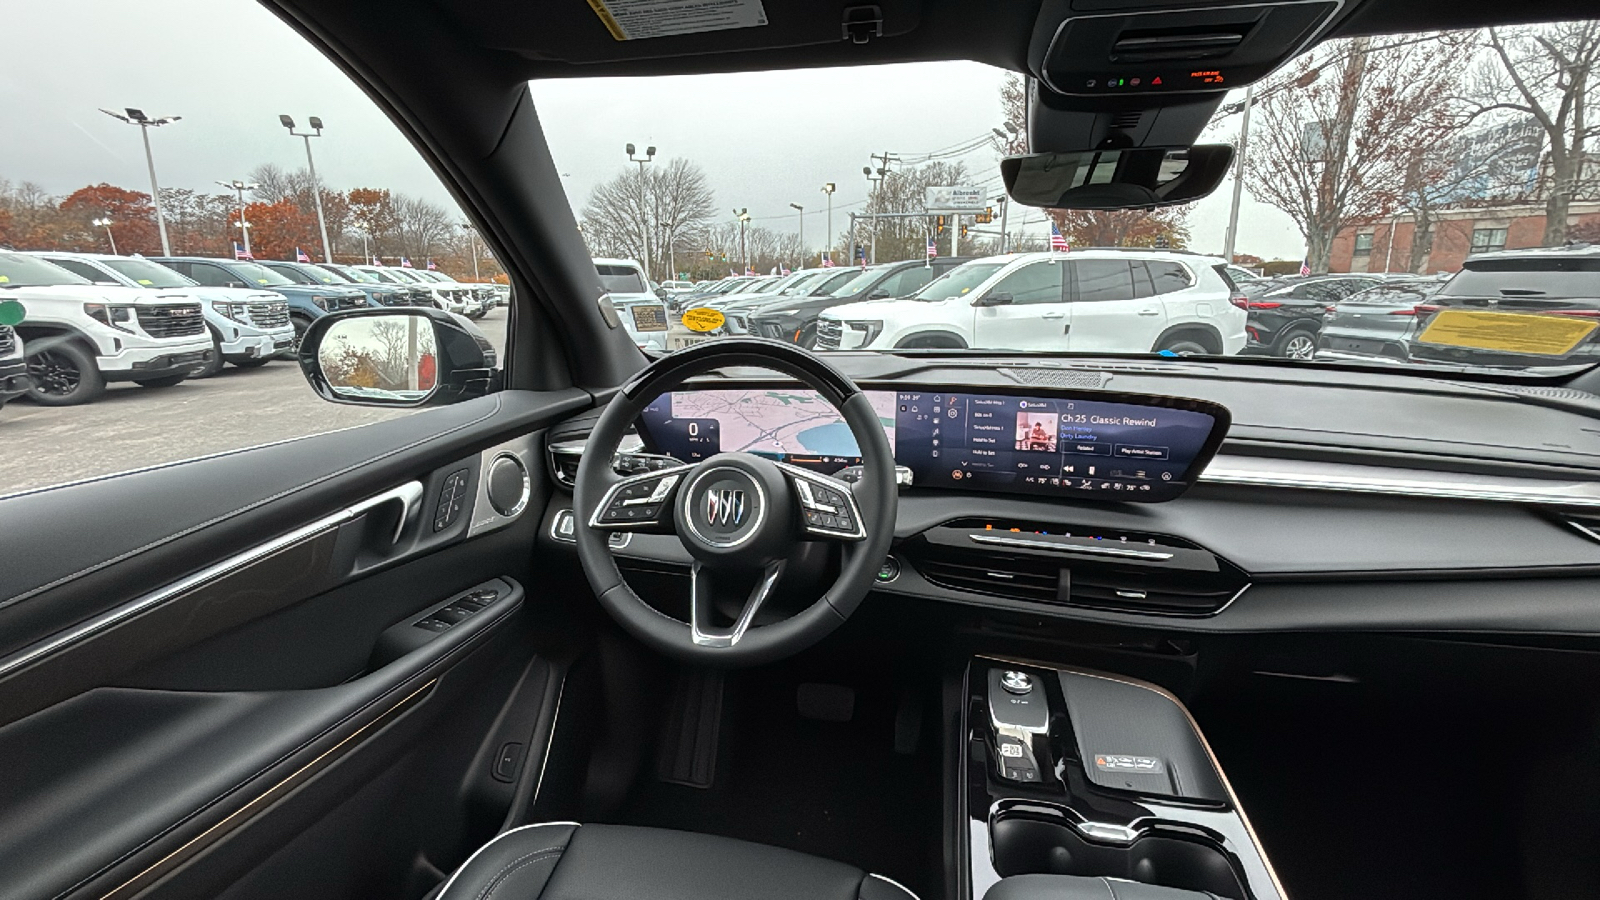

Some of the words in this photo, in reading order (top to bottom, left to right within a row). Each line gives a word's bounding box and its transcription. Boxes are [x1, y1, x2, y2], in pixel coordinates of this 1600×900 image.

[1061, 413, 1074, 423] Ch
[1074, 414, 1087, 424] 25
[1090, 415, 1121, 426] Classic
[1122, 417, 1157, 428] Rewind
[688, 422, 698, 436] 0
[1060, 432, 1074, 440] Dirty
[1074, 433, 1098, 441] Laundry
[1121, 447, 1131, 455] Play
